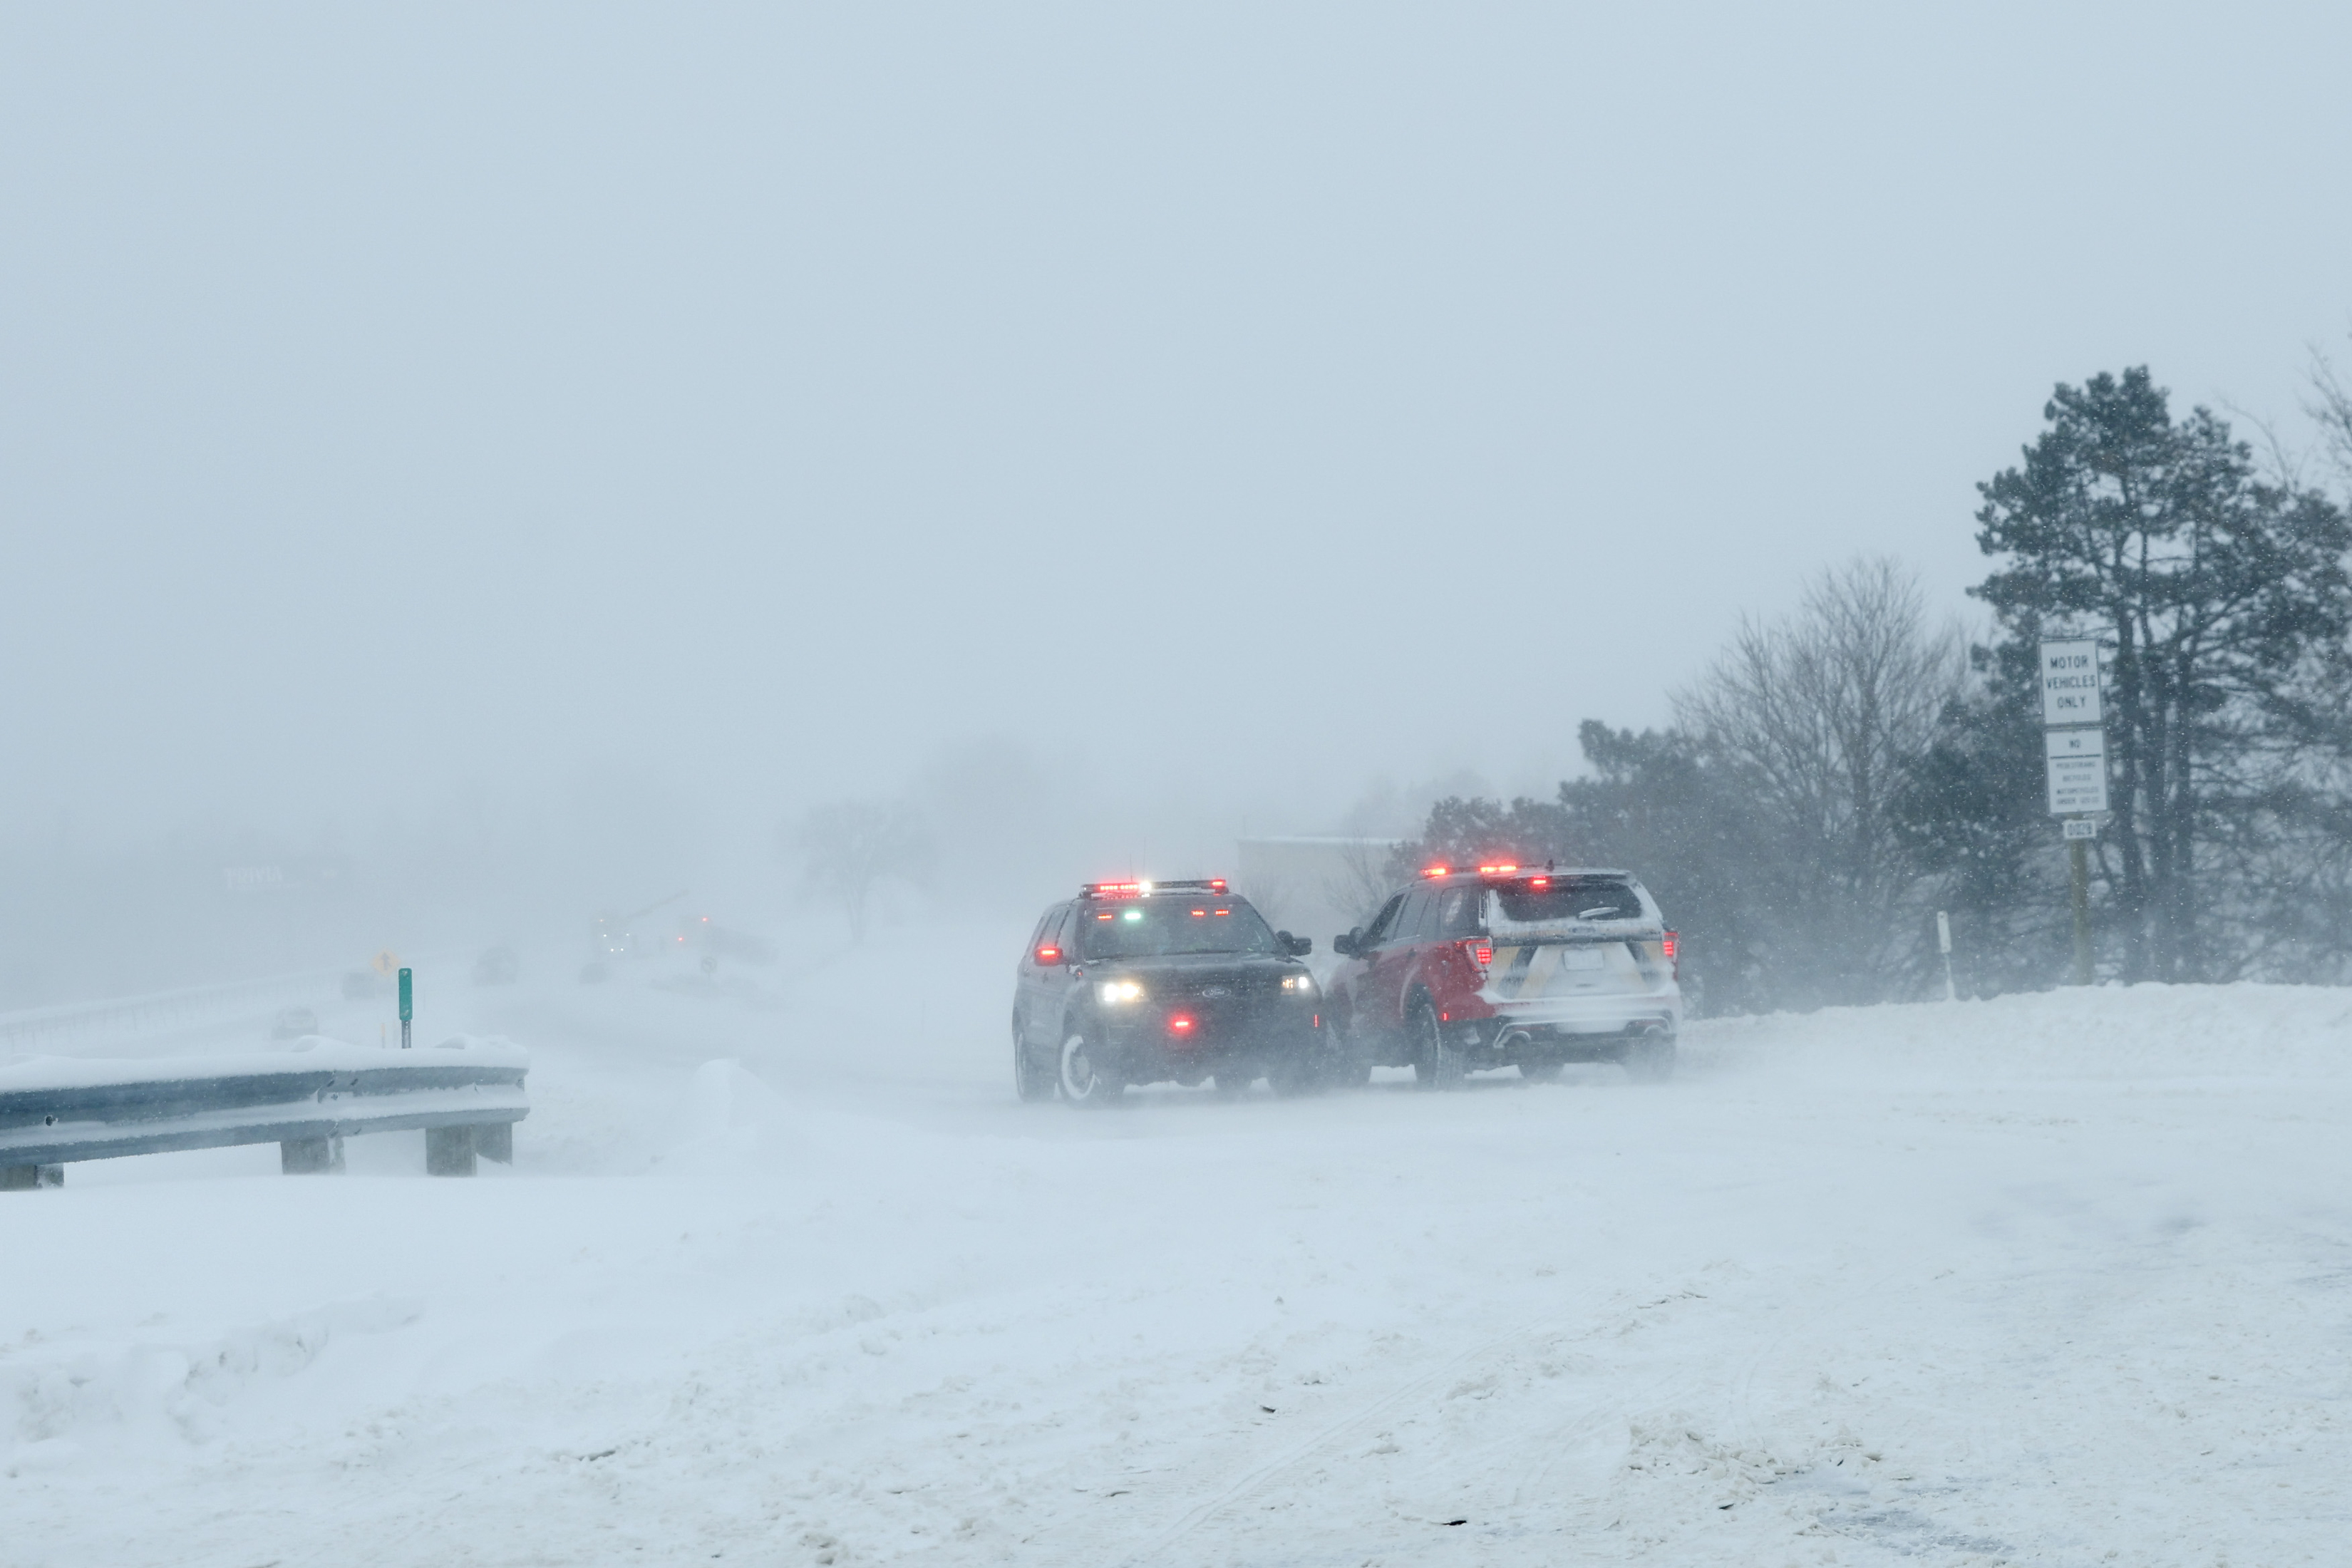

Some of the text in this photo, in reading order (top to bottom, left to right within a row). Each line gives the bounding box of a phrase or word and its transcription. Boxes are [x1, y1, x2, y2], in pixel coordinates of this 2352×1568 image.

[2050, 655, 2089, 669] MOTOR
[2046, 674, 2095, 689] VEHICLES
[2057, 696, 2086, 708] ONLY
[2069, 739, 2081, 748] NO
